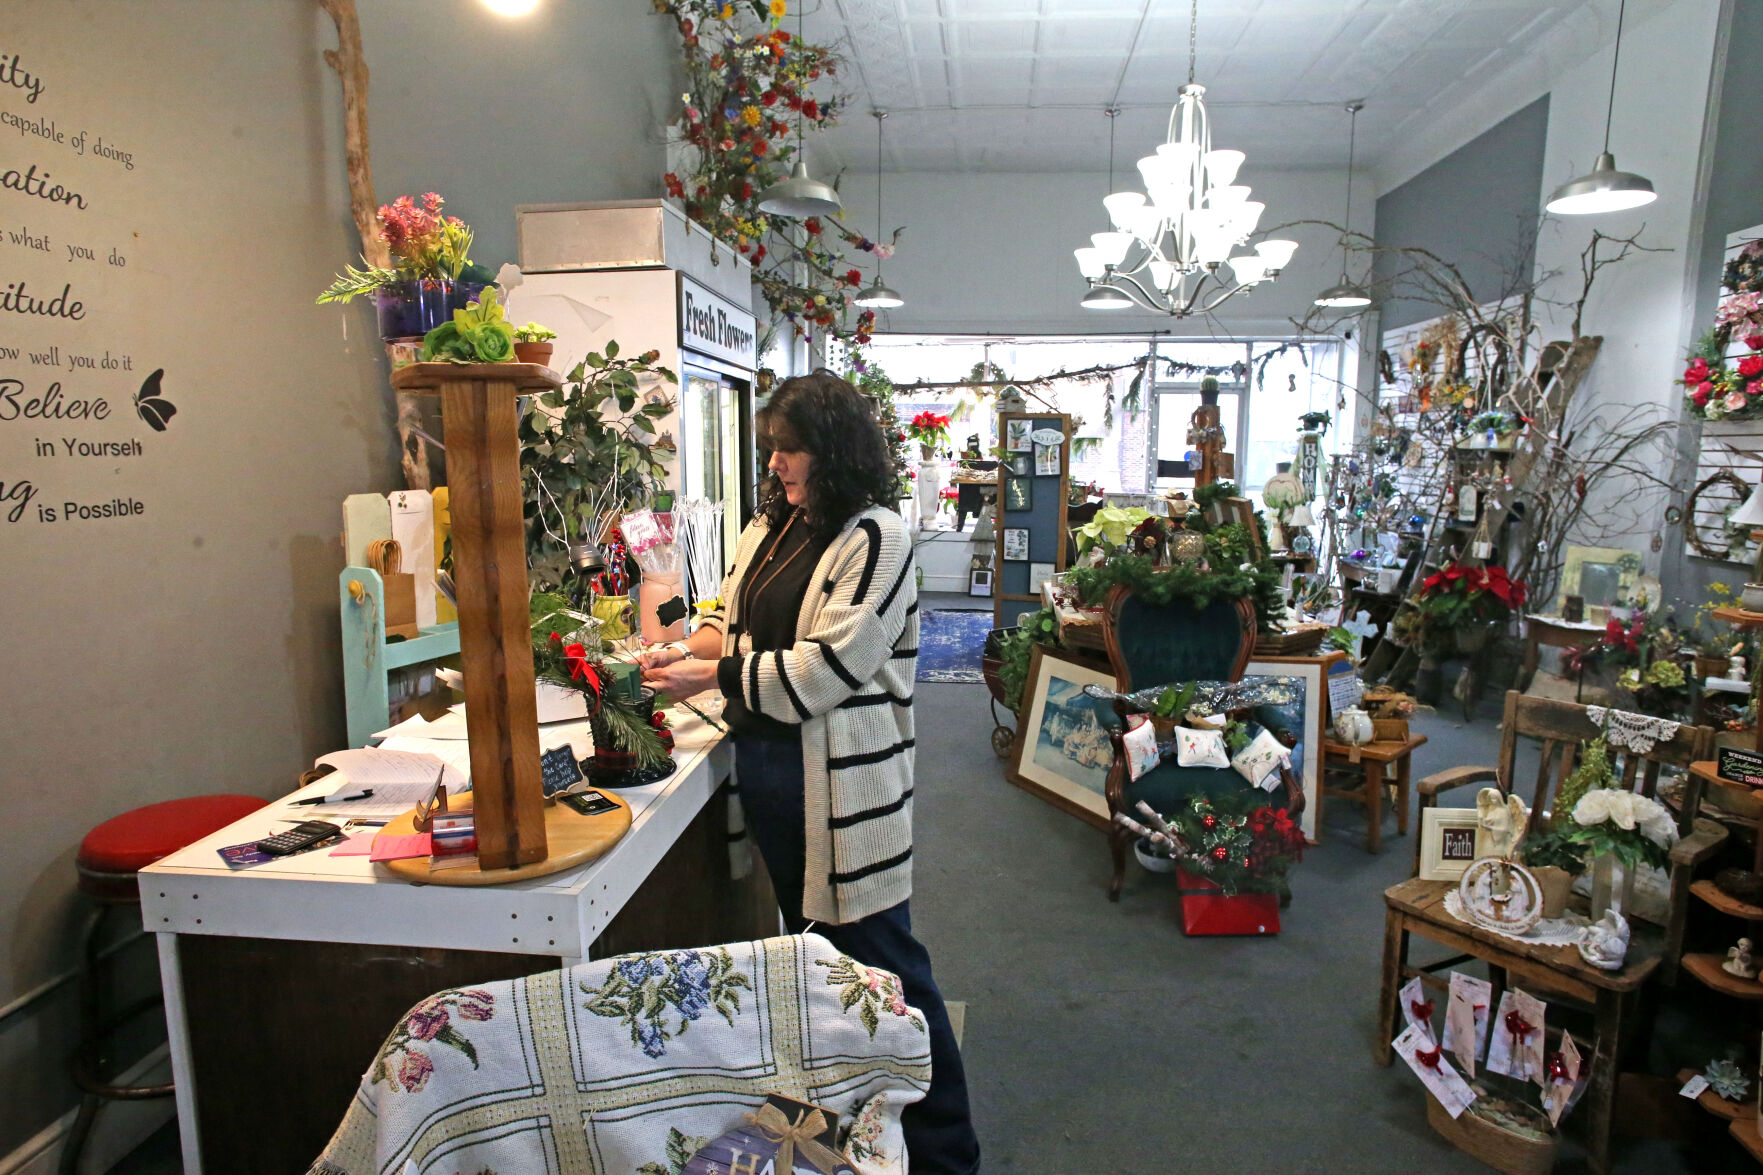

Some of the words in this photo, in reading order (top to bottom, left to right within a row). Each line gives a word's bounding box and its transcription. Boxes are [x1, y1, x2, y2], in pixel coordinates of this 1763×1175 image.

[0, 111, 64, 144] capable
[71, 130, 88, 155] of
[93, 136, 134, 170] doing
[0, 164, 88, 210] ation
[8, 226, 51, 252] what
[66, 244, 95, 262] you
[108, 247, 126, 267] do
[685, 290, 716, 343] Fresh
[717, 308, 753, 353] Flowers
[28, 346, 60, 366] well
[68, 354, 96, 372] you
[101, 350, 118, 370] do
[122, 354, 133, 371] it
[0, 378, 111, 421] Believe
[35, 438, 55, 456] in
[37, 503, 57, 522] is
[64, 497, 144, 521] Possible
[1444, 832, 1472, 857] Faith
